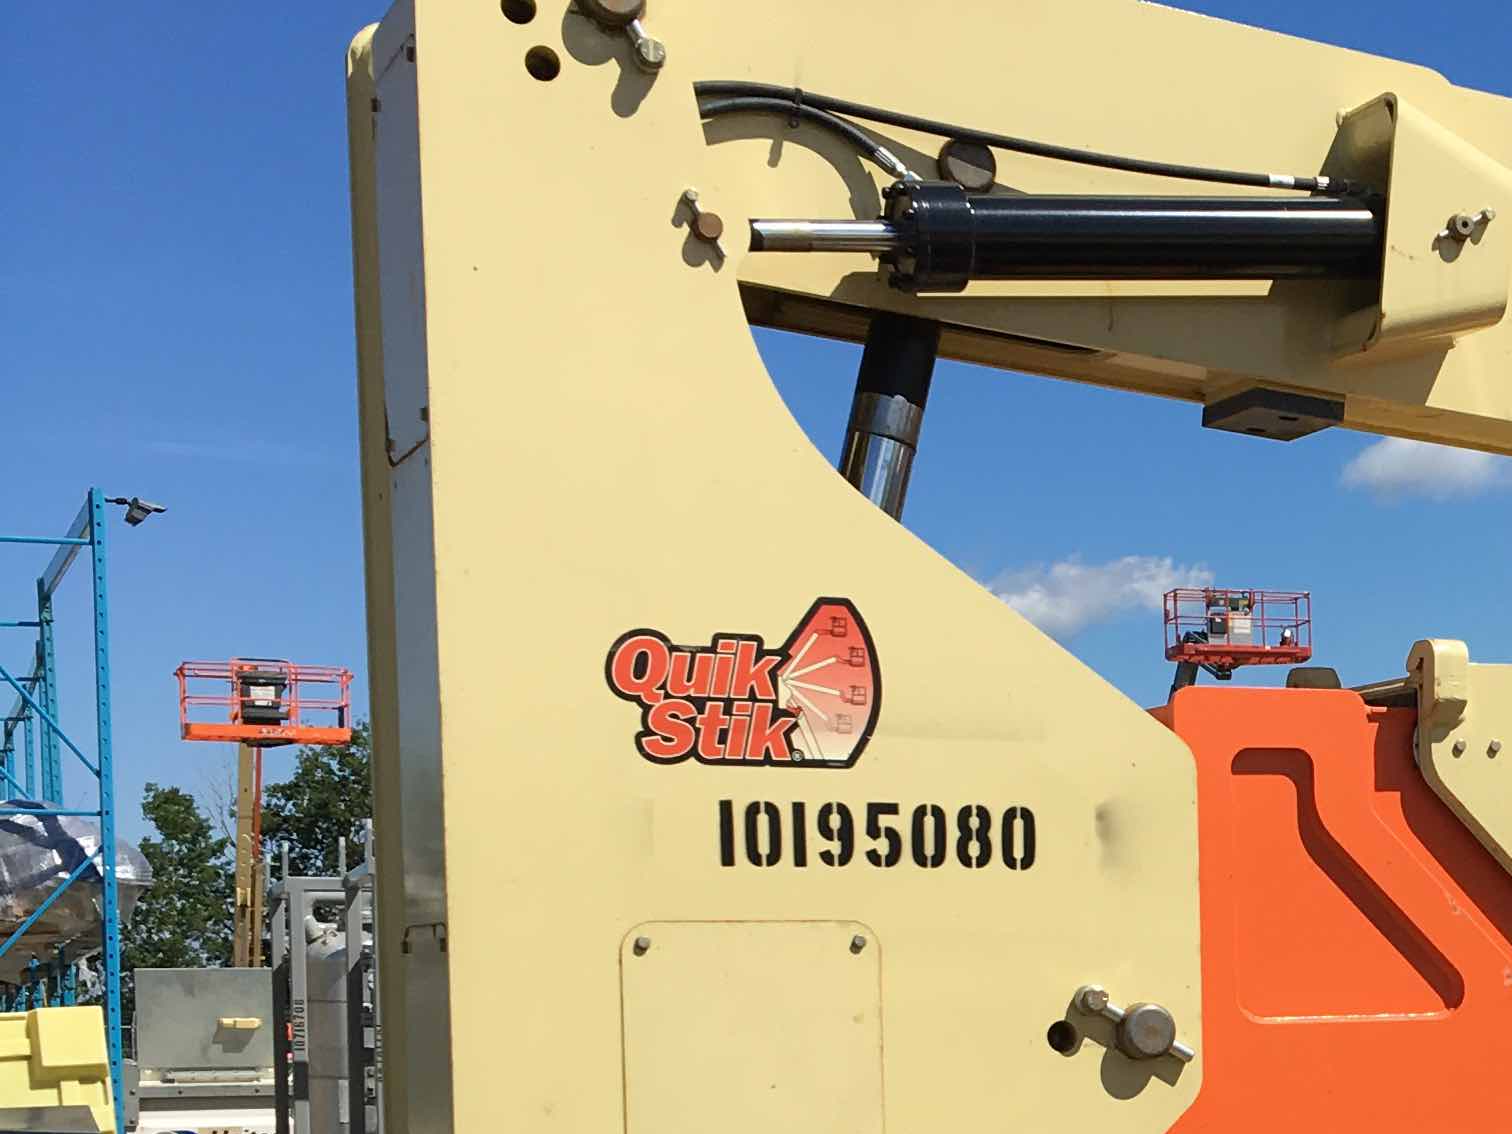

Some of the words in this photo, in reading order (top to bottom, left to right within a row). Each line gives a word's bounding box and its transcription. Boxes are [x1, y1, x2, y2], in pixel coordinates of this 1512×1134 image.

[611, 635, 782, 705] Quik
[641, 698, 798, 761] Stik
[719, 799, 1036, 871] 10195080
